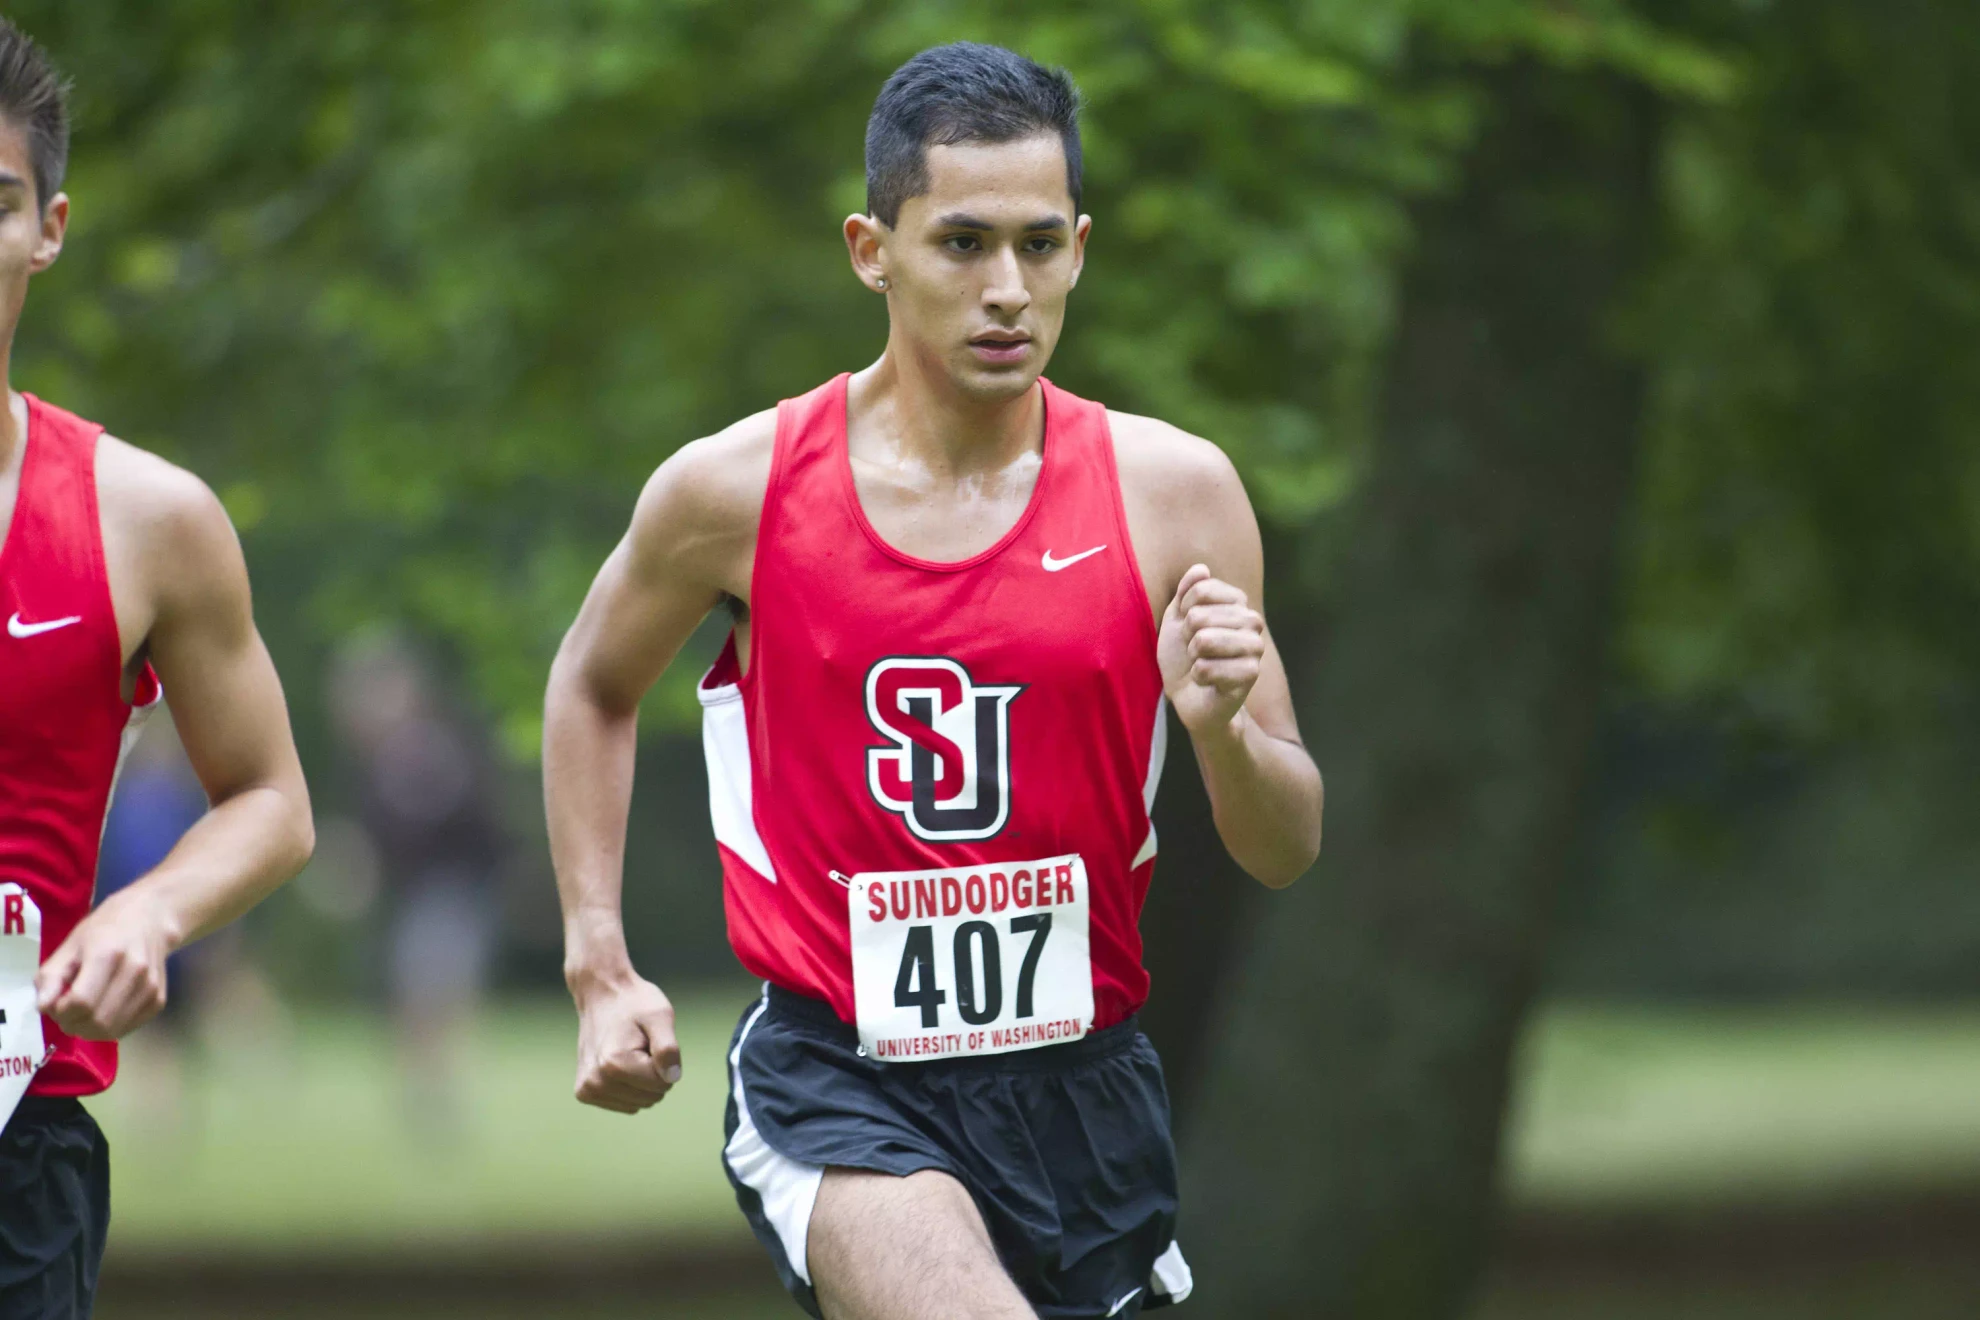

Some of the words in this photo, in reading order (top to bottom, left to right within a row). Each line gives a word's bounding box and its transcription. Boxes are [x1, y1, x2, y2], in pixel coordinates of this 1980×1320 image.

[868, 864, 1075, 922] SUNDODGER
[894, 912, 1052, 1028] 407
[877, 1034, 961, 1056] UNIVERSITY
[968, 1031, 985, 1050] OF
[992, 1018, 1081, 1047] WASHINGTON
